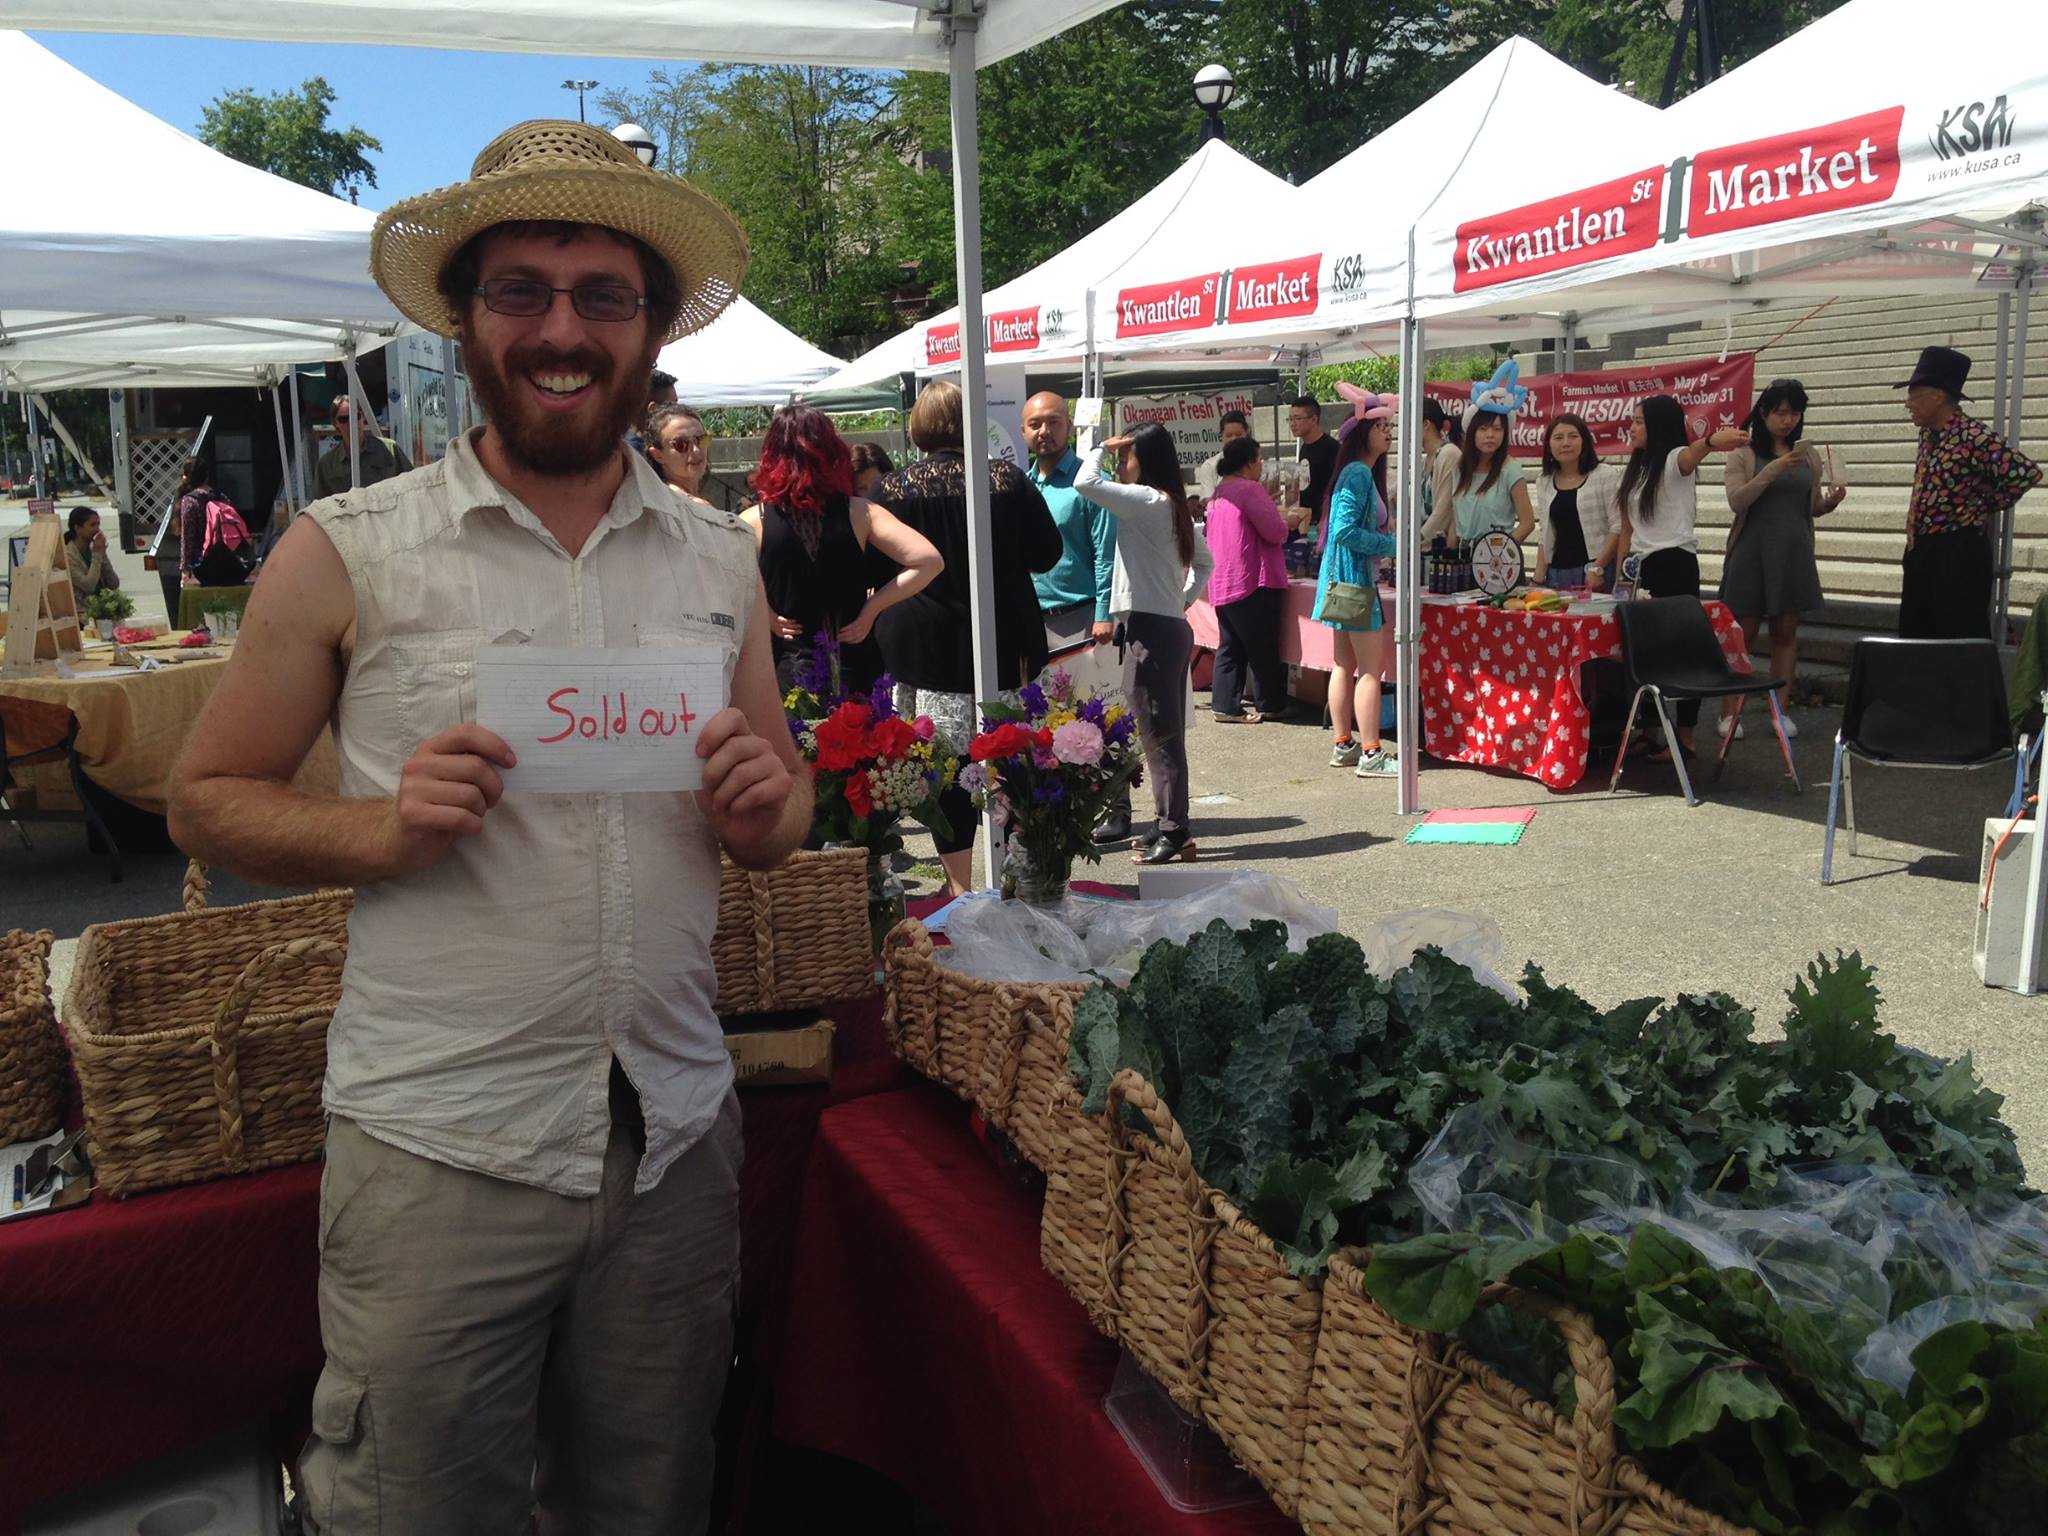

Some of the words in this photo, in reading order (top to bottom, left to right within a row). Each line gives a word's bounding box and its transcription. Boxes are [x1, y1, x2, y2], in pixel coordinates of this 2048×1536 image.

[1928, 94, 2017, 161] KSA
[1927, 153, 2021, 183] www.kusa.ca
[1467, 206, 1626, 274] Kwantlen
[1630, 177, 1654, 204] St
[1704, 137, 1880, 215] Market
[1331, 253, 1366, 293] KSA
[1122, 291, 1201, 327] Kwantlen
[1203, 278, 1215, 294] St
[1236, 271, 1310, 311] Market
[993, 316, 1034, 343] Market
[1562, 384, 1593, 396] Farmers
[1593, 383, 1619, 394] Market
[1672, 390, 1719, 406] October
[1719, 388, 1734, 402] 31
[1674, 375, 1697, 392] May
[1699, 373, 1708, 388] 9
[1123, 402, 1177, 425] Okanagan
[1178, 399, 1214, 420] Fresh
[1215, 395, 1252, 417] Fruits
[1178, 430, 1201, 444] Farm
[537, 687, 627, 744] Sold
[639, 692, 697, 737] out
